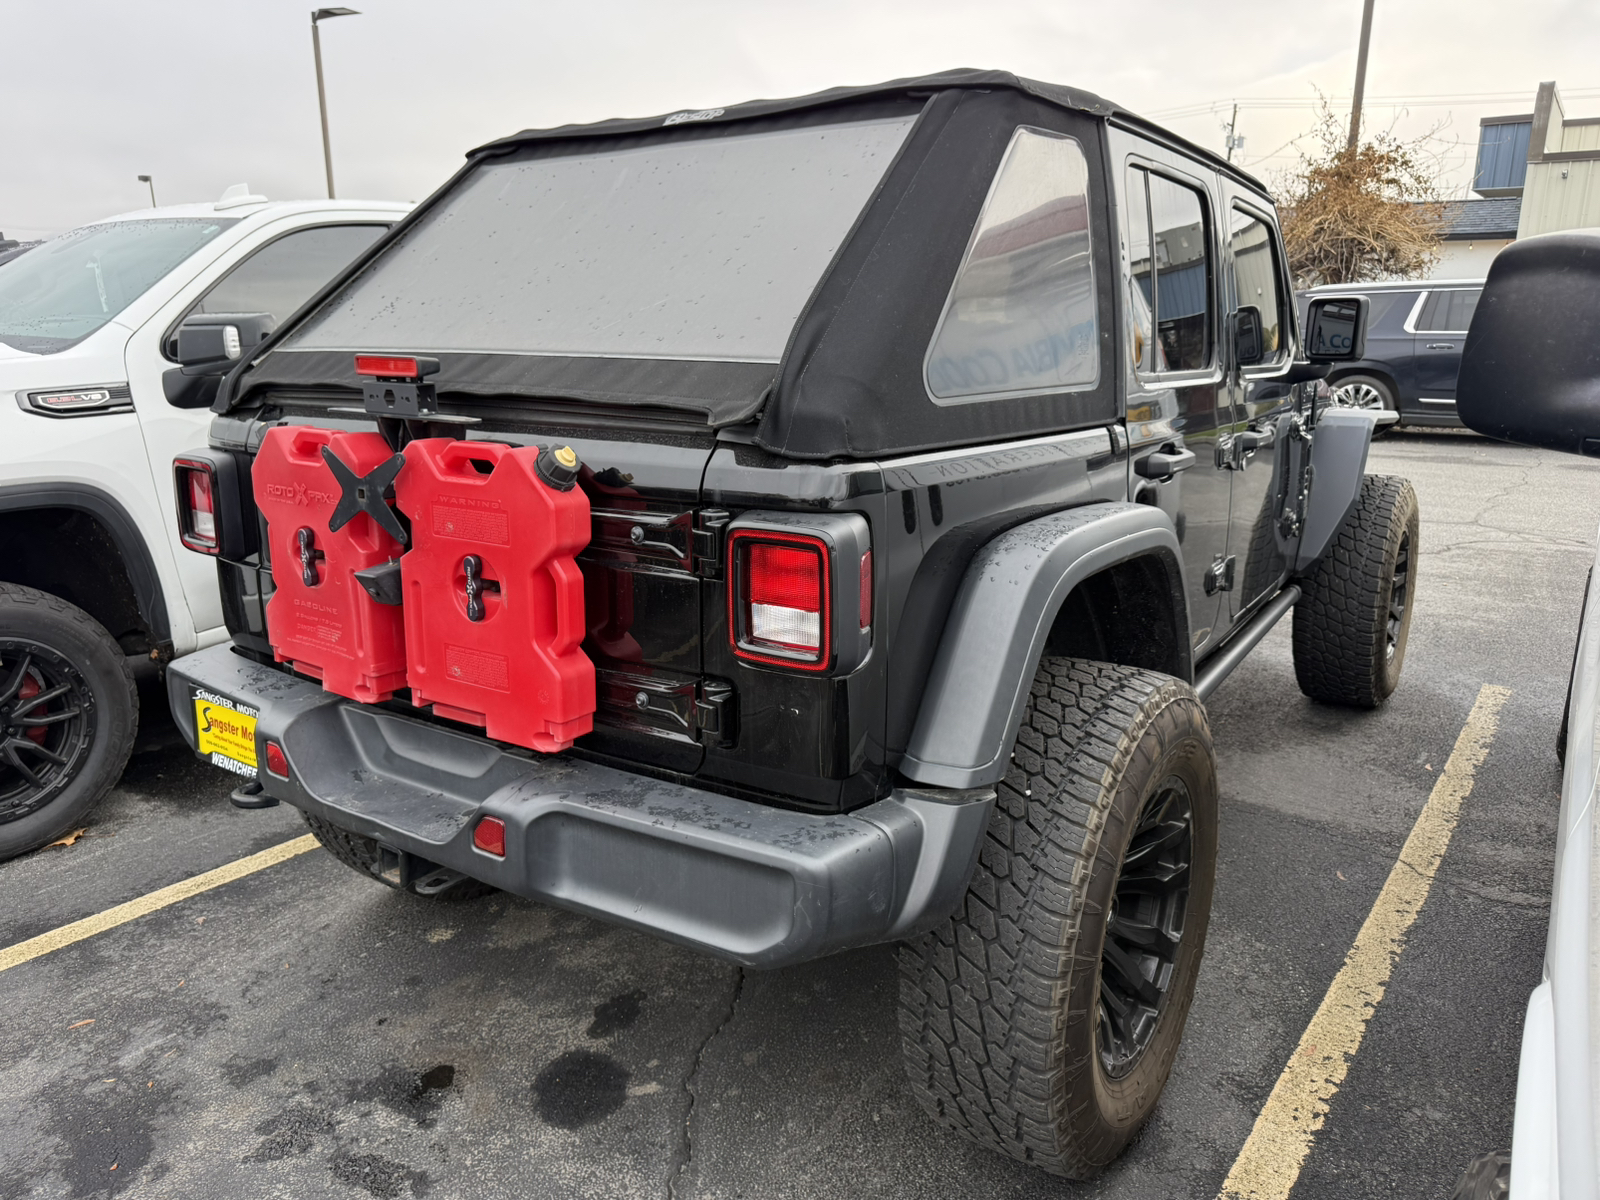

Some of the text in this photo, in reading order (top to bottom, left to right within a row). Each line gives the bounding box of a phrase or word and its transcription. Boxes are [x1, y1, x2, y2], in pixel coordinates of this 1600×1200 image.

[438, 495, 500, 509] WARNING
[293, 598, 338, 615] GASOLINE
[192, 690, 259, 719] SANGSTER MOTO
[201, 707, 255, 742] Sangster Mo
